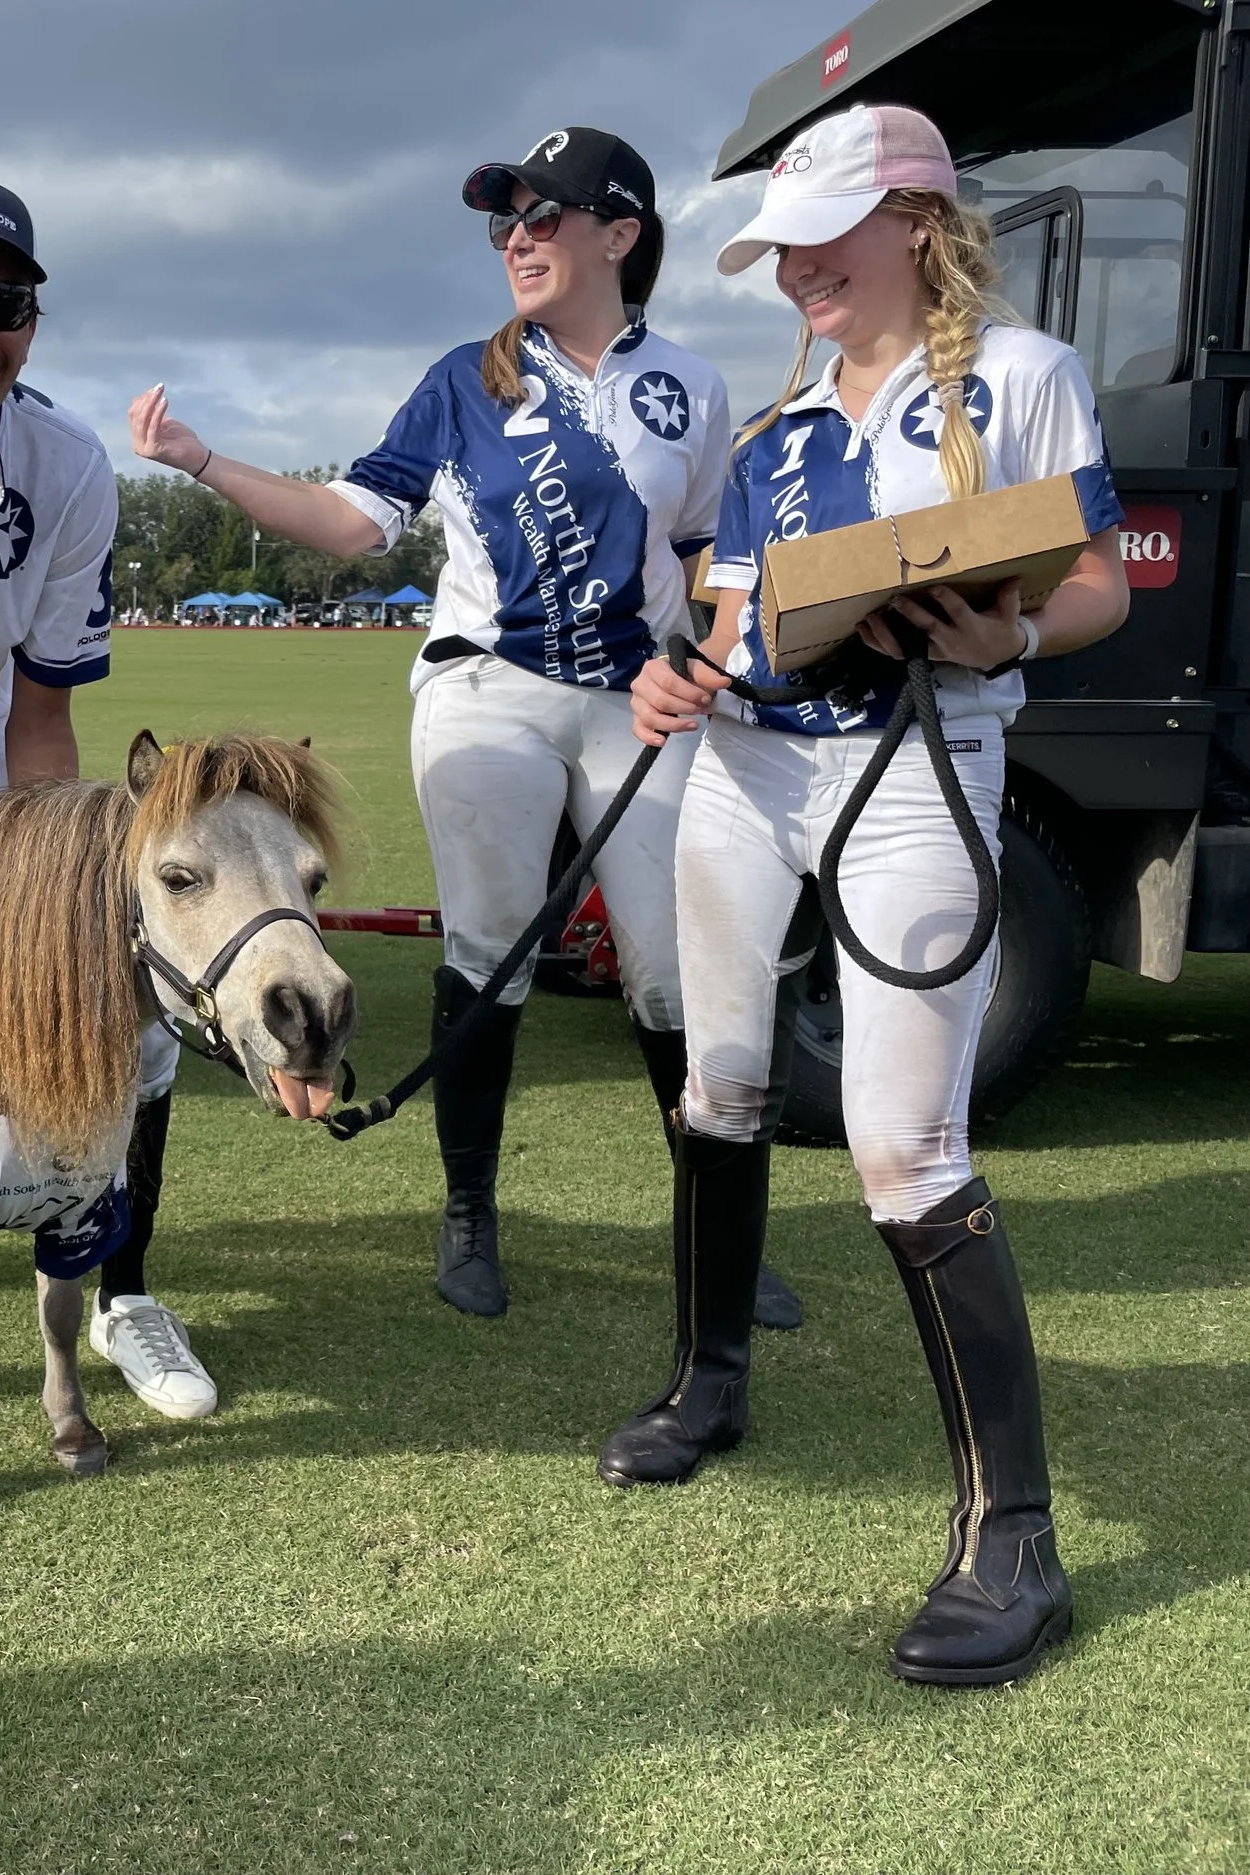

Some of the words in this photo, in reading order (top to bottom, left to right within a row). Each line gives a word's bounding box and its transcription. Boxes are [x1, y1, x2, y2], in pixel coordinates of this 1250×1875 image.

[824, 45, 849, 76] TORO
[503, 374, 549, 438] 2
[770, 424, 814, 480] 1
[517, 440, 597, 577] North
[568, 579, 616, 690] South
[1118, 531, 1171, 562] RO
[512, 491, 552, 567] Wealth
[536, 565, 564, 683] Manament
